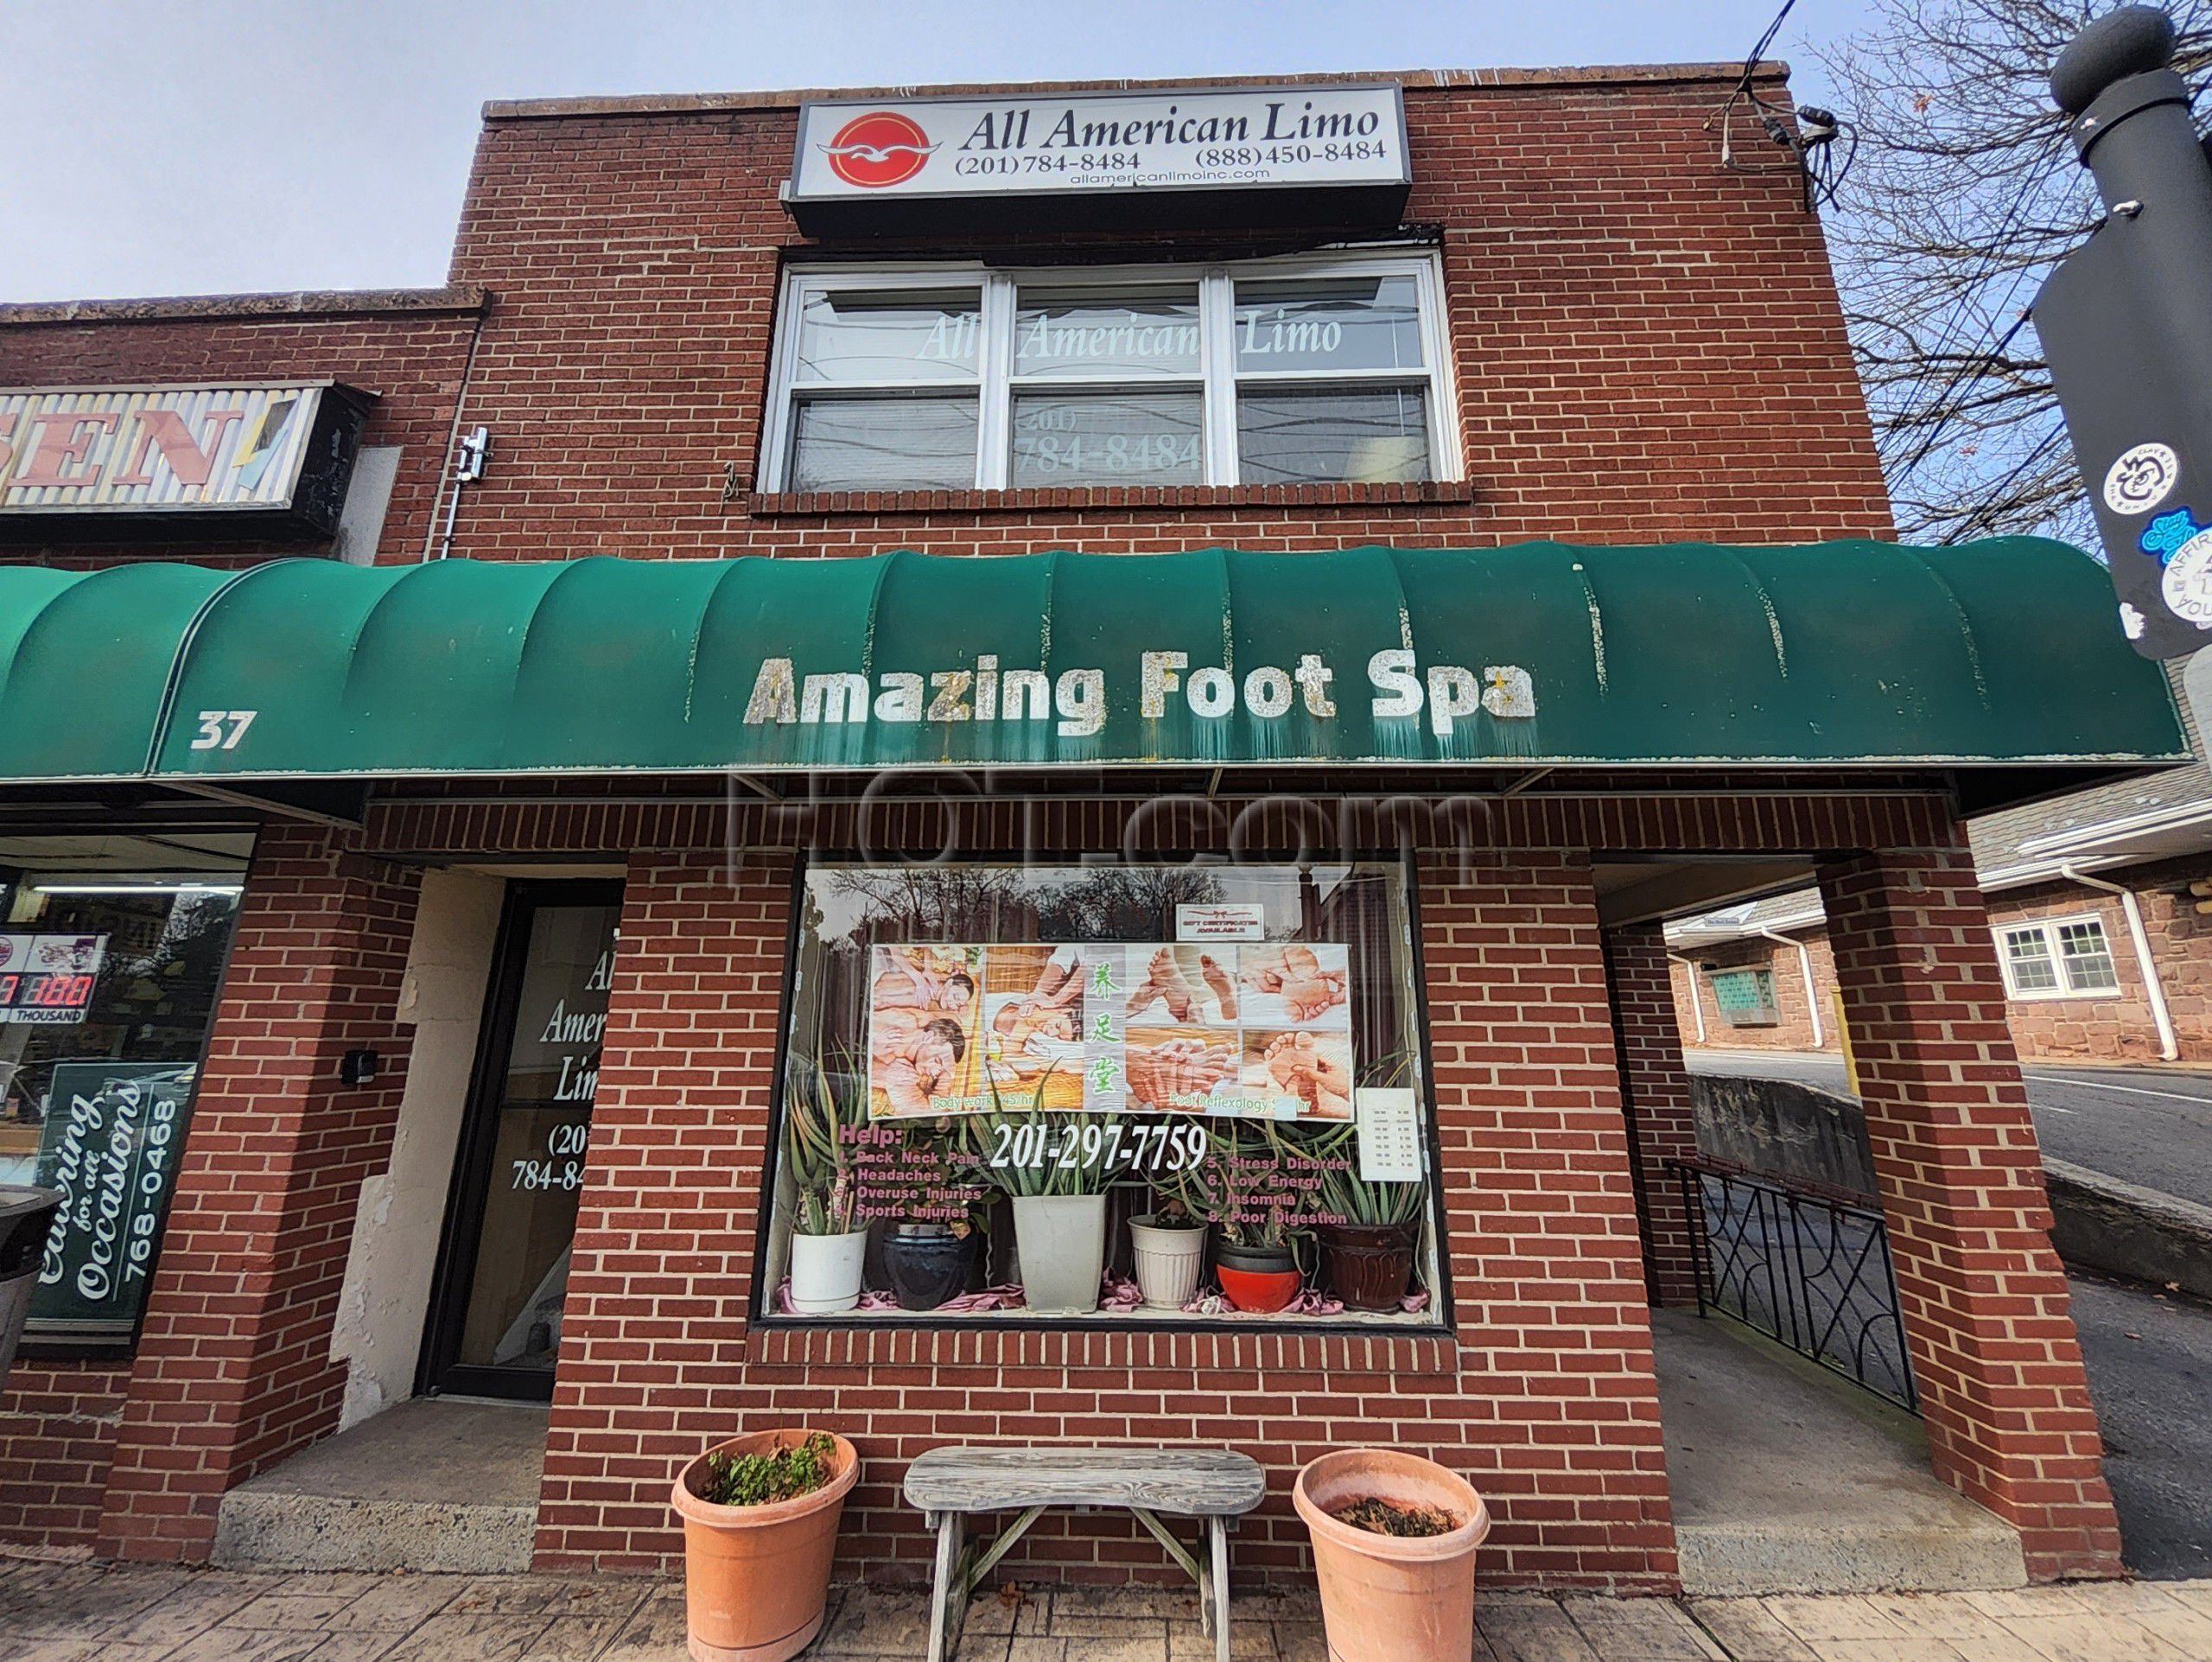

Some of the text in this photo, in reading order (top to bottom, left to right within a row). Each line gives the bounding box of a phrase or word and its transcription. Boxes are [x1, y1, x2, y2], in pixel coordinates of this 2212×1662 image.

[958, 101, 1379, 150] All American Limo
[1071, 168, 1270, 184] allamericanlimoinc.com
[917, 309, 1342, 360] All American Limo
[0, 411, 244, 487] EN
[1014, 434, 1199, 473] 784-8484
[742, 648, 1536, 736] Amazing Foot Spa
[191, 710, 257, 749] 37
[17, 1009, 82, 1022] THOUSAND
[1090, 961, 1122, 1095] 养足堂
[932, 1096, 961, 1109] Body
[1170, 1092, 1198, 1105] Foot
[1198, 1094, 1268, 1112] Reflexology
[839, 1124, 902, 1148] Help:
[990, 1124, 1207, 1170] 201-297-7759
[856, 1150, 894, 1163] Back
[902, 1150, 939, 1163] Neck
[948, 1152, 980, 1165] Pain
[1230, 1156, 1279, 1169] Stress
[1287, 1157, 1352, 1170] Disorder
[857, 1168, 941, 1181] Headaches
[1207, 1175, 1323, 1189] 6. Low Energy
[73, 1149, 101, 1232] for all
[77, 1079, 142, 1300] Occasions
[125, 1099, 176, 1283] 768-0468
[856, 1187, 918, 1199] Overuse
[926, 1187, 982, 1201] Injuries
[1227, 1193, 1295, 1206] Insomnia
[855, 1203, 906, 1218] Sports
[912, 1204, 969, 1219] Injuries
[1208, 1210, 1347, 1226] 8. Poor Digestion
